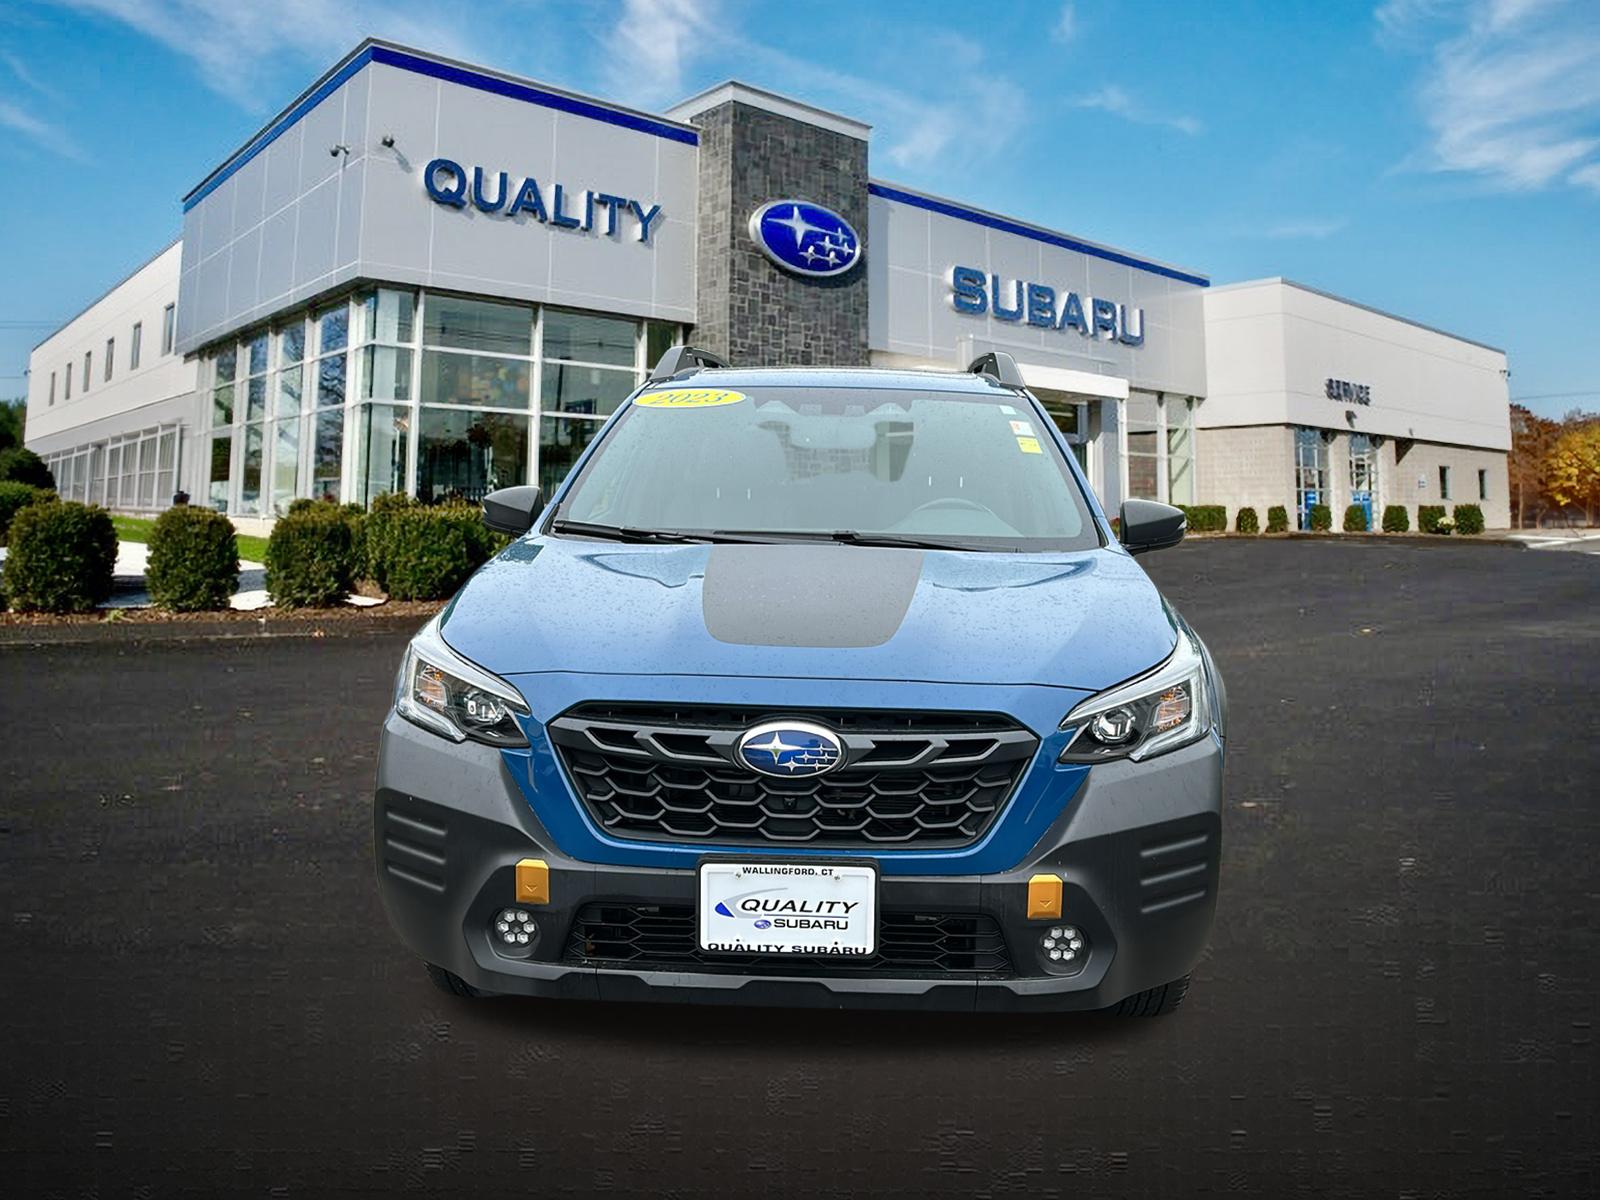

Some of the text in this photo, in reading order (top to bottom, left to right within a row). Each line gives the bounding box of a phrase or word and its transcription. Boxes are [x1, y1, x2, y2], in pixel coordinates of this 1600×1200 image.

[424, 157, 661, 242] QUALITY
[952, 265, 1145, 346] SUBARU
[650, 392, 729, 404] 2023
[821, 868, 834, 876] CT
[741, 898, 858, 914] QUALITY
[773, 919, 848, 930] SUBARU
[707, 943, 867, 955] QUALITY SUBARU
